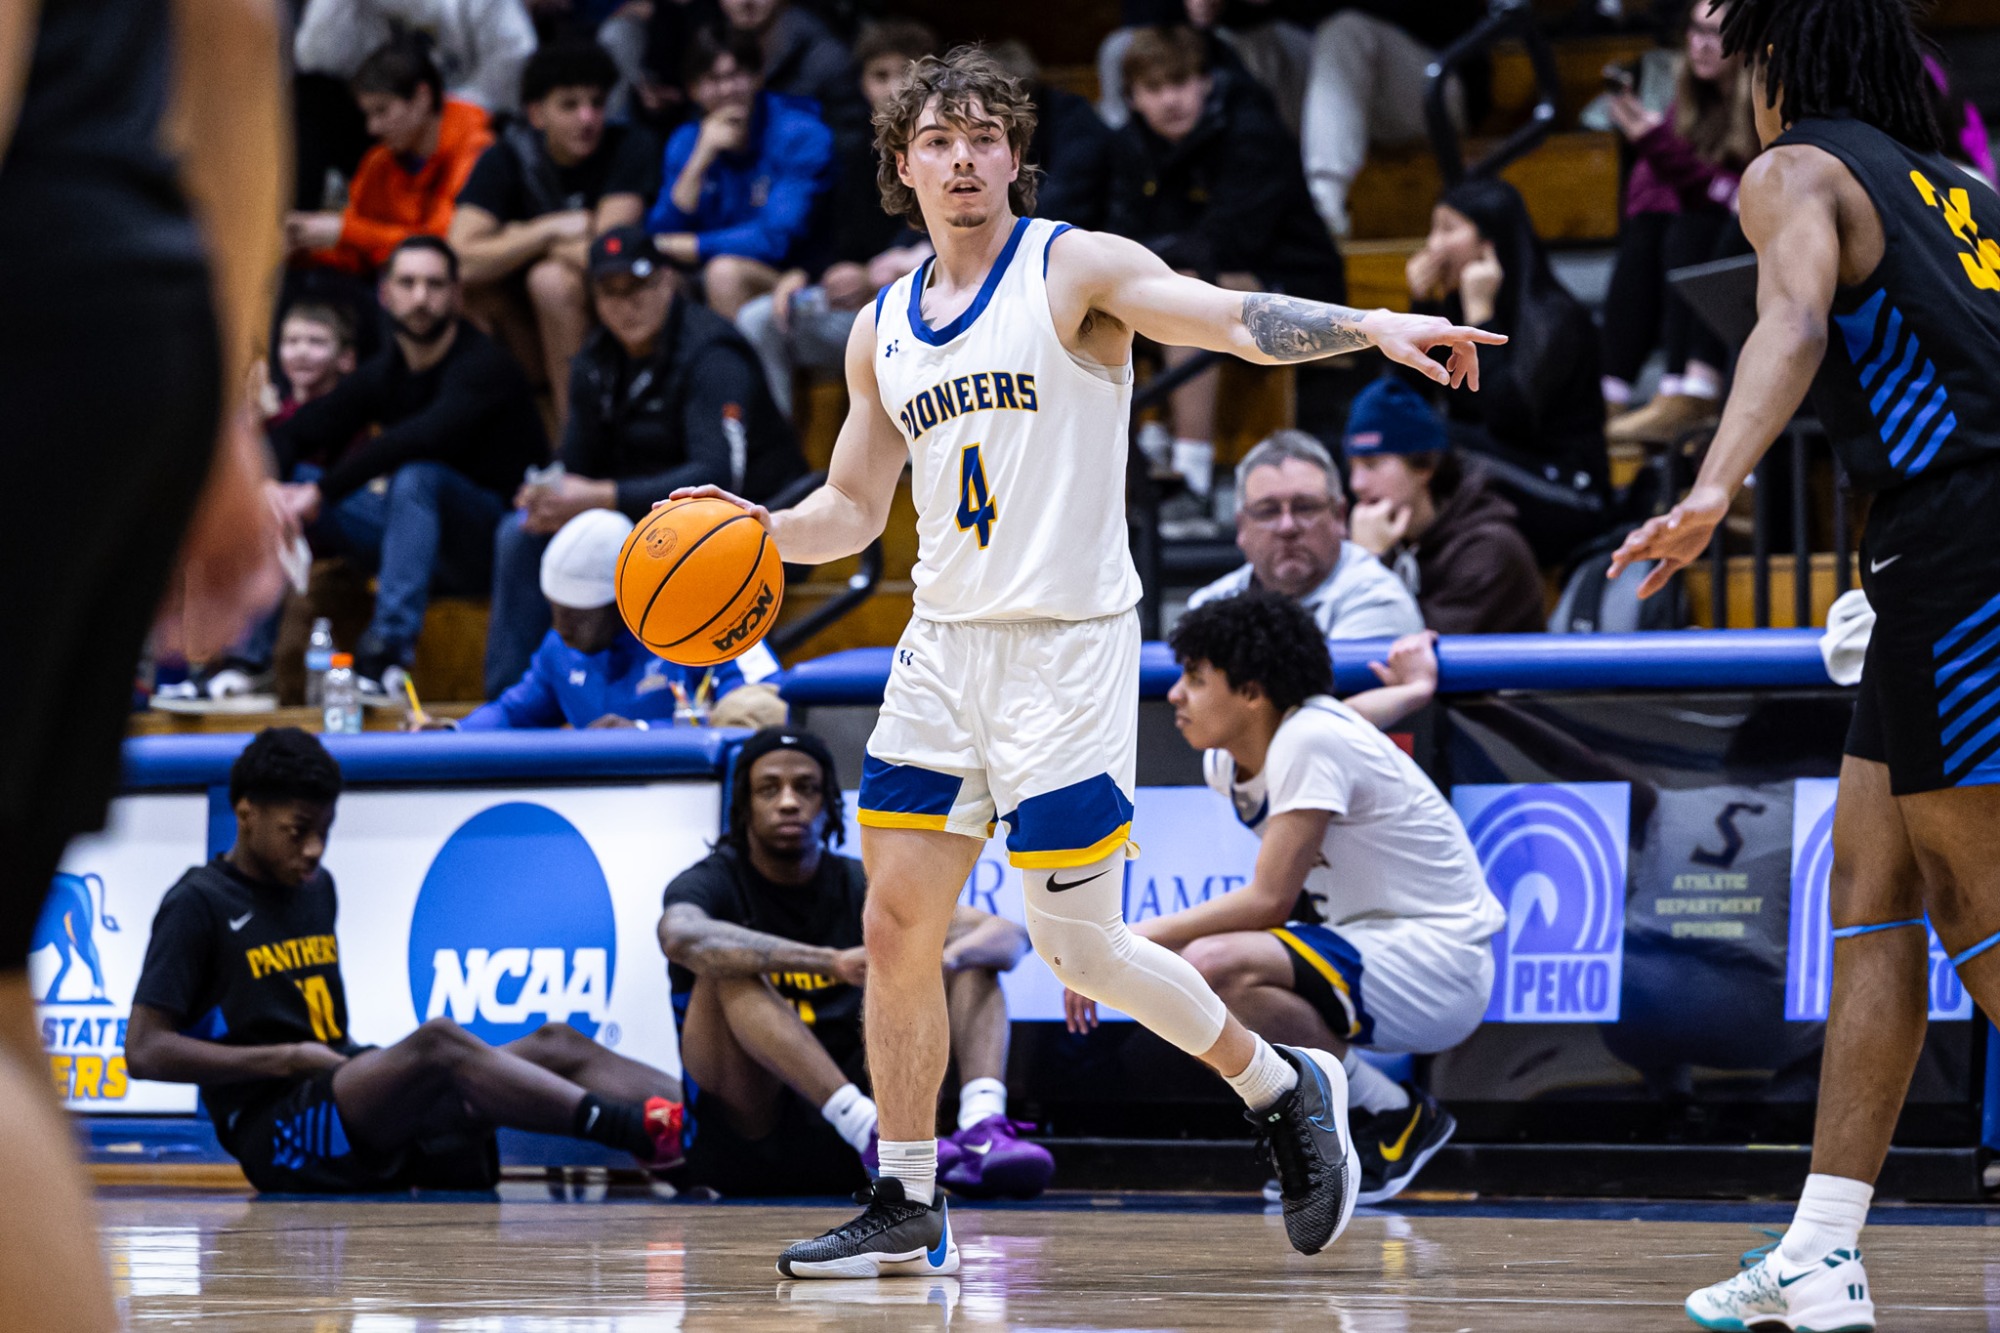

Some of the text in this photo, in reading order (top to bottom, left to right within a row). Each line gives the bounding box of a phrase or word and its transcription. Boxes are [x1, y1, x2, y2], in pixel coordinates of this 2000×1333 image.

[900, 371, 1038, 441] PIONEERS
[955, 442, 998, 551] 4
[712, 583, 774, 652] NCAA
[426, 947, 608, 1024] NCAA
[1512, 960, 1609, 1014] PEKO
